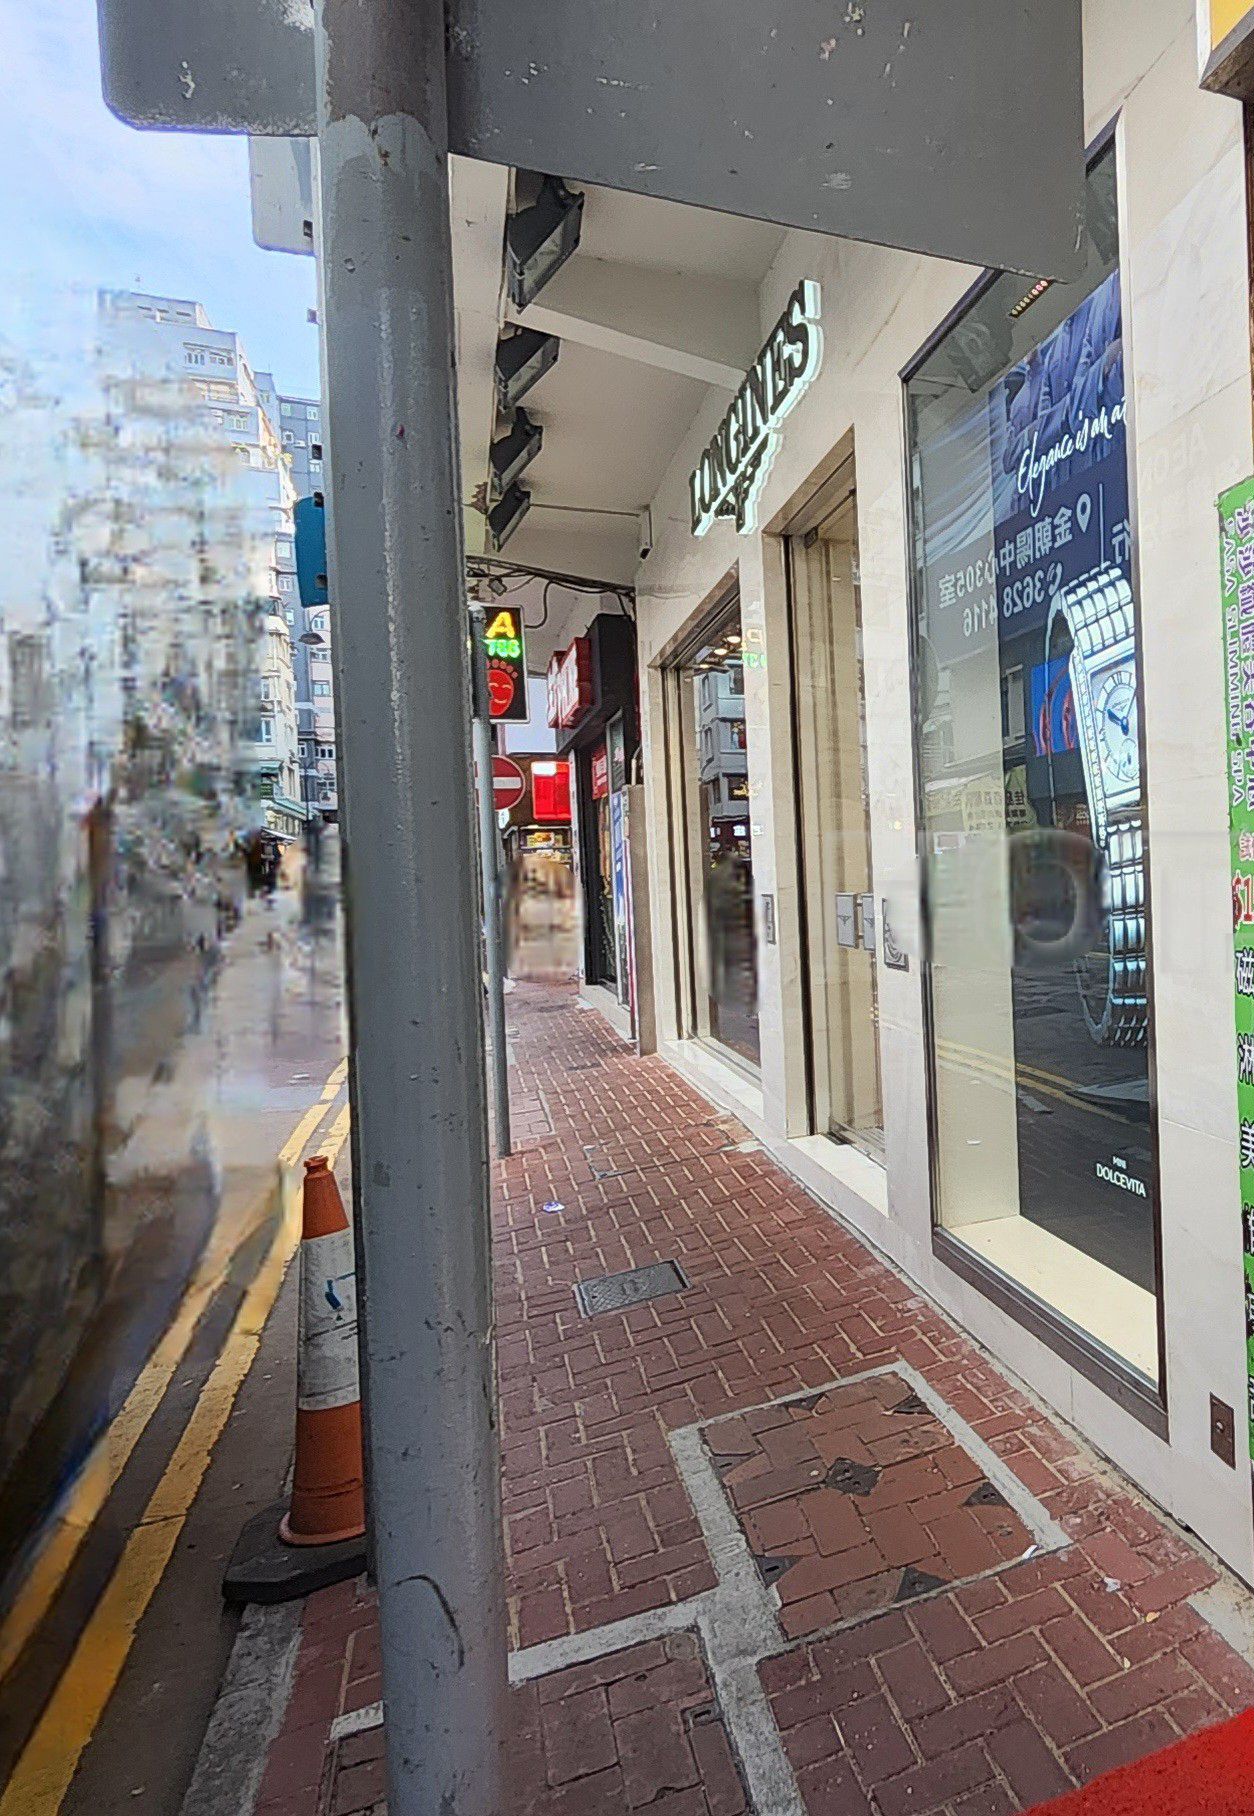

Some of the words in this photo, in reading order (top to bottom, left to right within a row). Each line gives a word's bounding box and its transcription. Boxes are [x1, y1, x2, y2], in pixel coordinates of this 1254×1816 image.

[690, 279, 820, 536] LONGINES
[1017, 431, 1073, 517] Elegance
[484, 611, 516, 639] A
